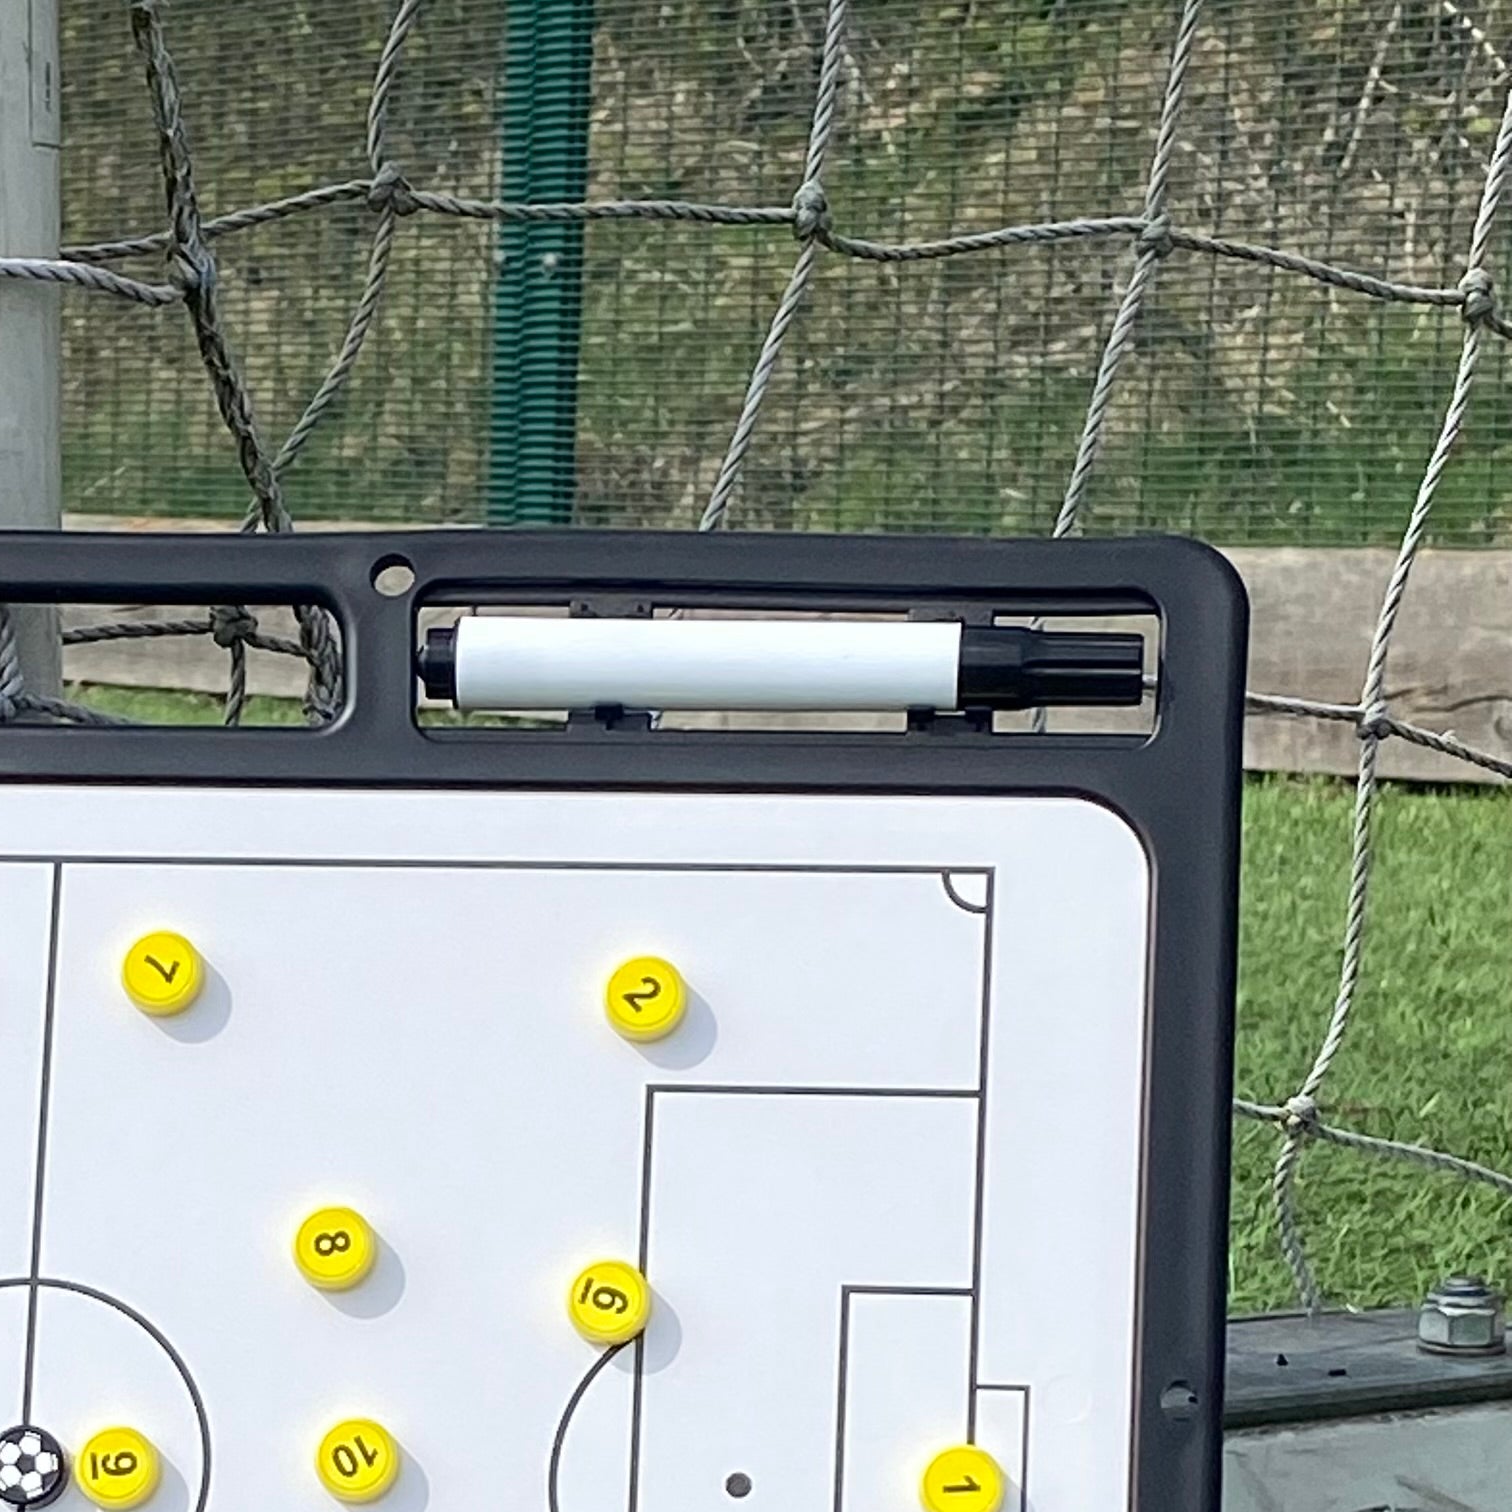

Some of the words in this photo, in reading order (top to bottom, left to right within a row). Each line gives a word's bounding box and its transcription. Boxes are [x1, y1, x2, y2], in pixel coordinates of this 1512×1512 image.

[142, 953, 182, 986] 7
[621, 975, 663, 1014] 2
[312, 1229, 352, 1258] 8
[330, 1434, 380, 1479] 10
[941, 1474, 983, 1495] 1
